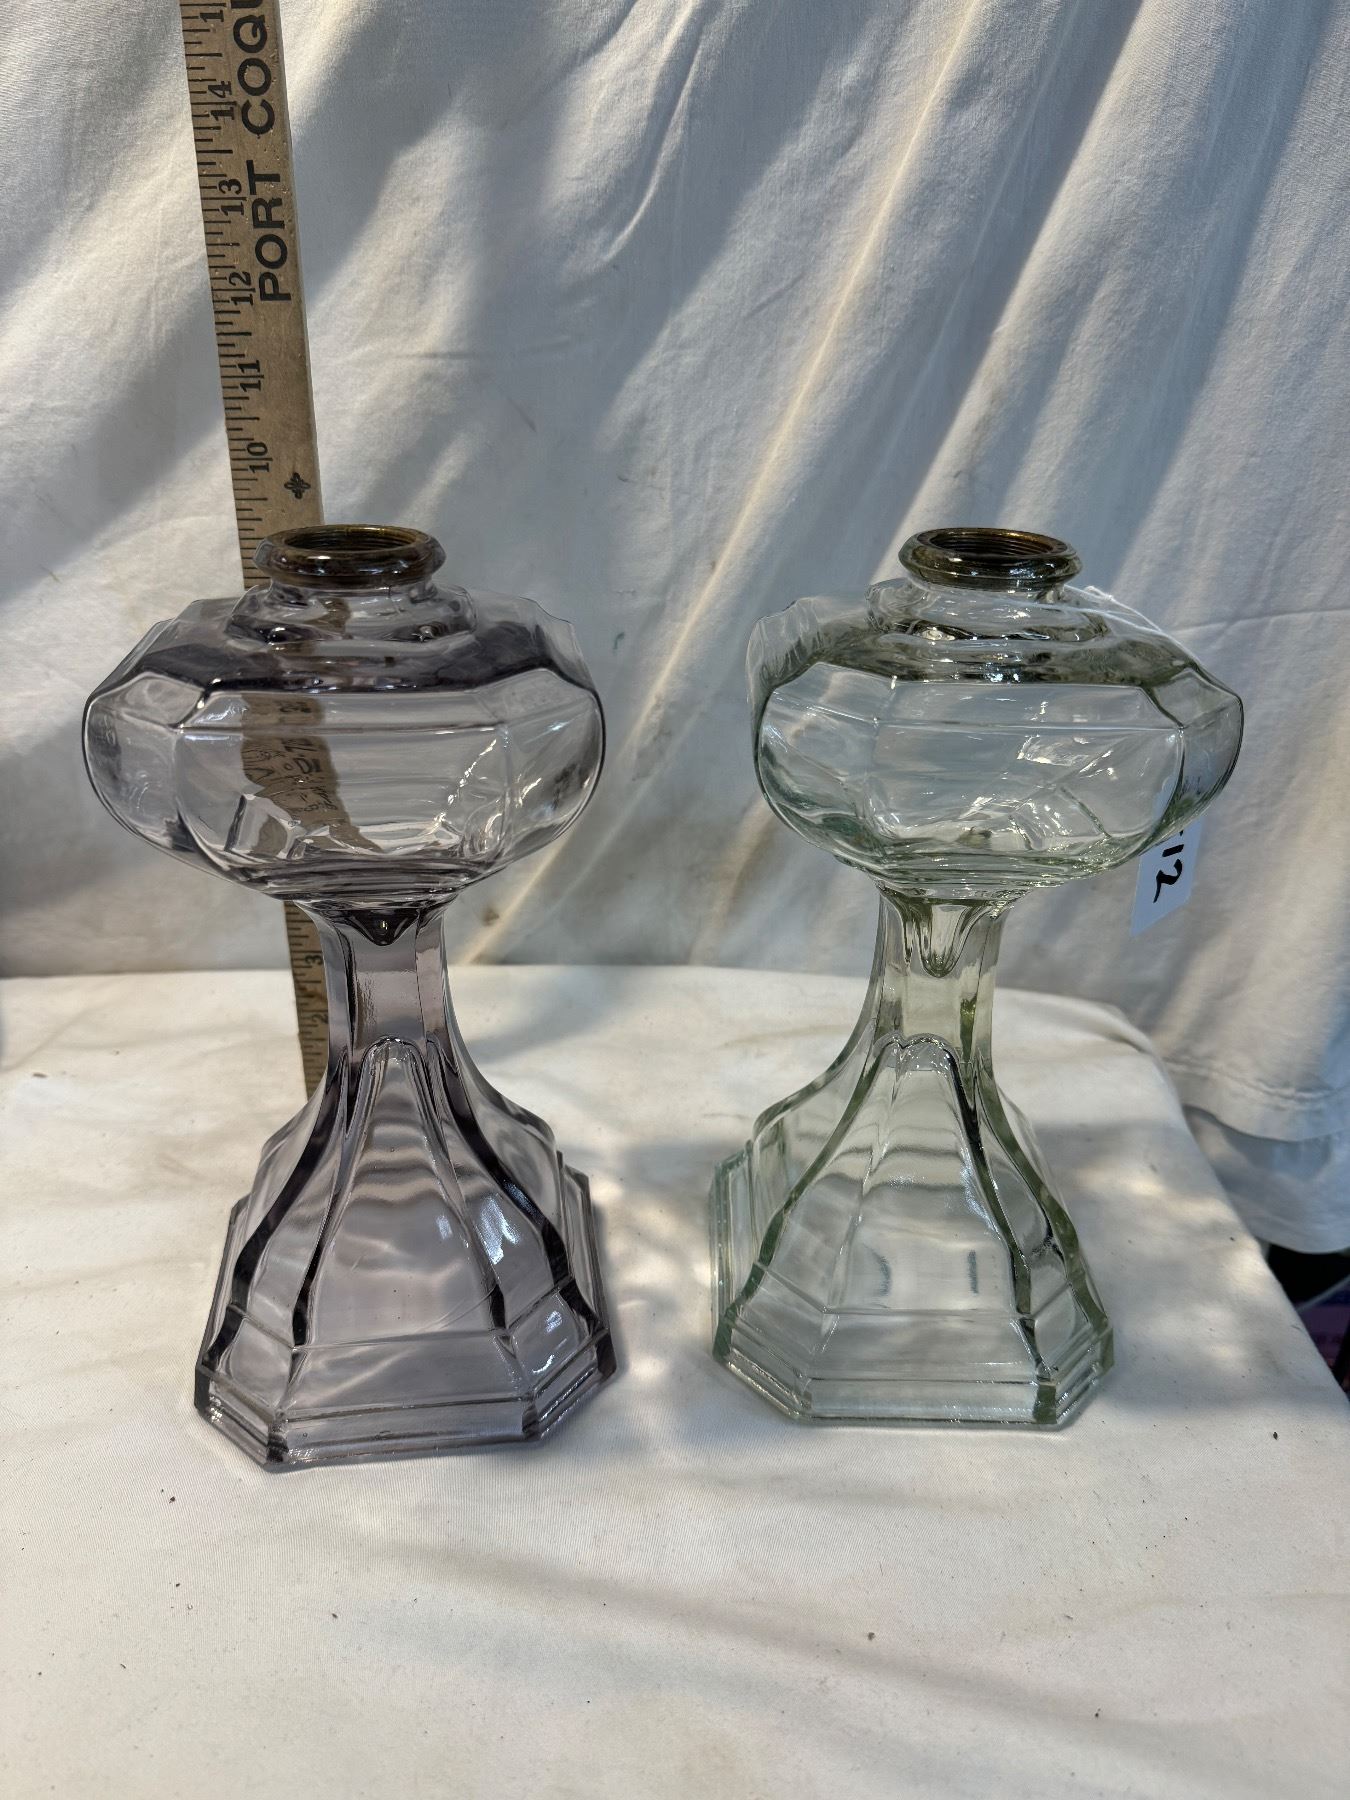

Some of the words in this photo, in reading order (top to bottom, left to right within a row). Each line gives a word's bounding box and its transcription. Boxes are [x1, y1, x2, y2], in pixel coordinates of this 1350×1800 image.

[230, 0, 275, 135] COQ
[208, 81, 235, 120] 14
[219, 178, 244, 216] 13
[246, 159, 291, 301] PORT
[229, 271, 254, 306] 12
[238, 359, 262, 392] 11
[246, 442, 270, 473] 10
[1153, 829, 1184, 903] 12
[305, 954, 323, 966] 3
